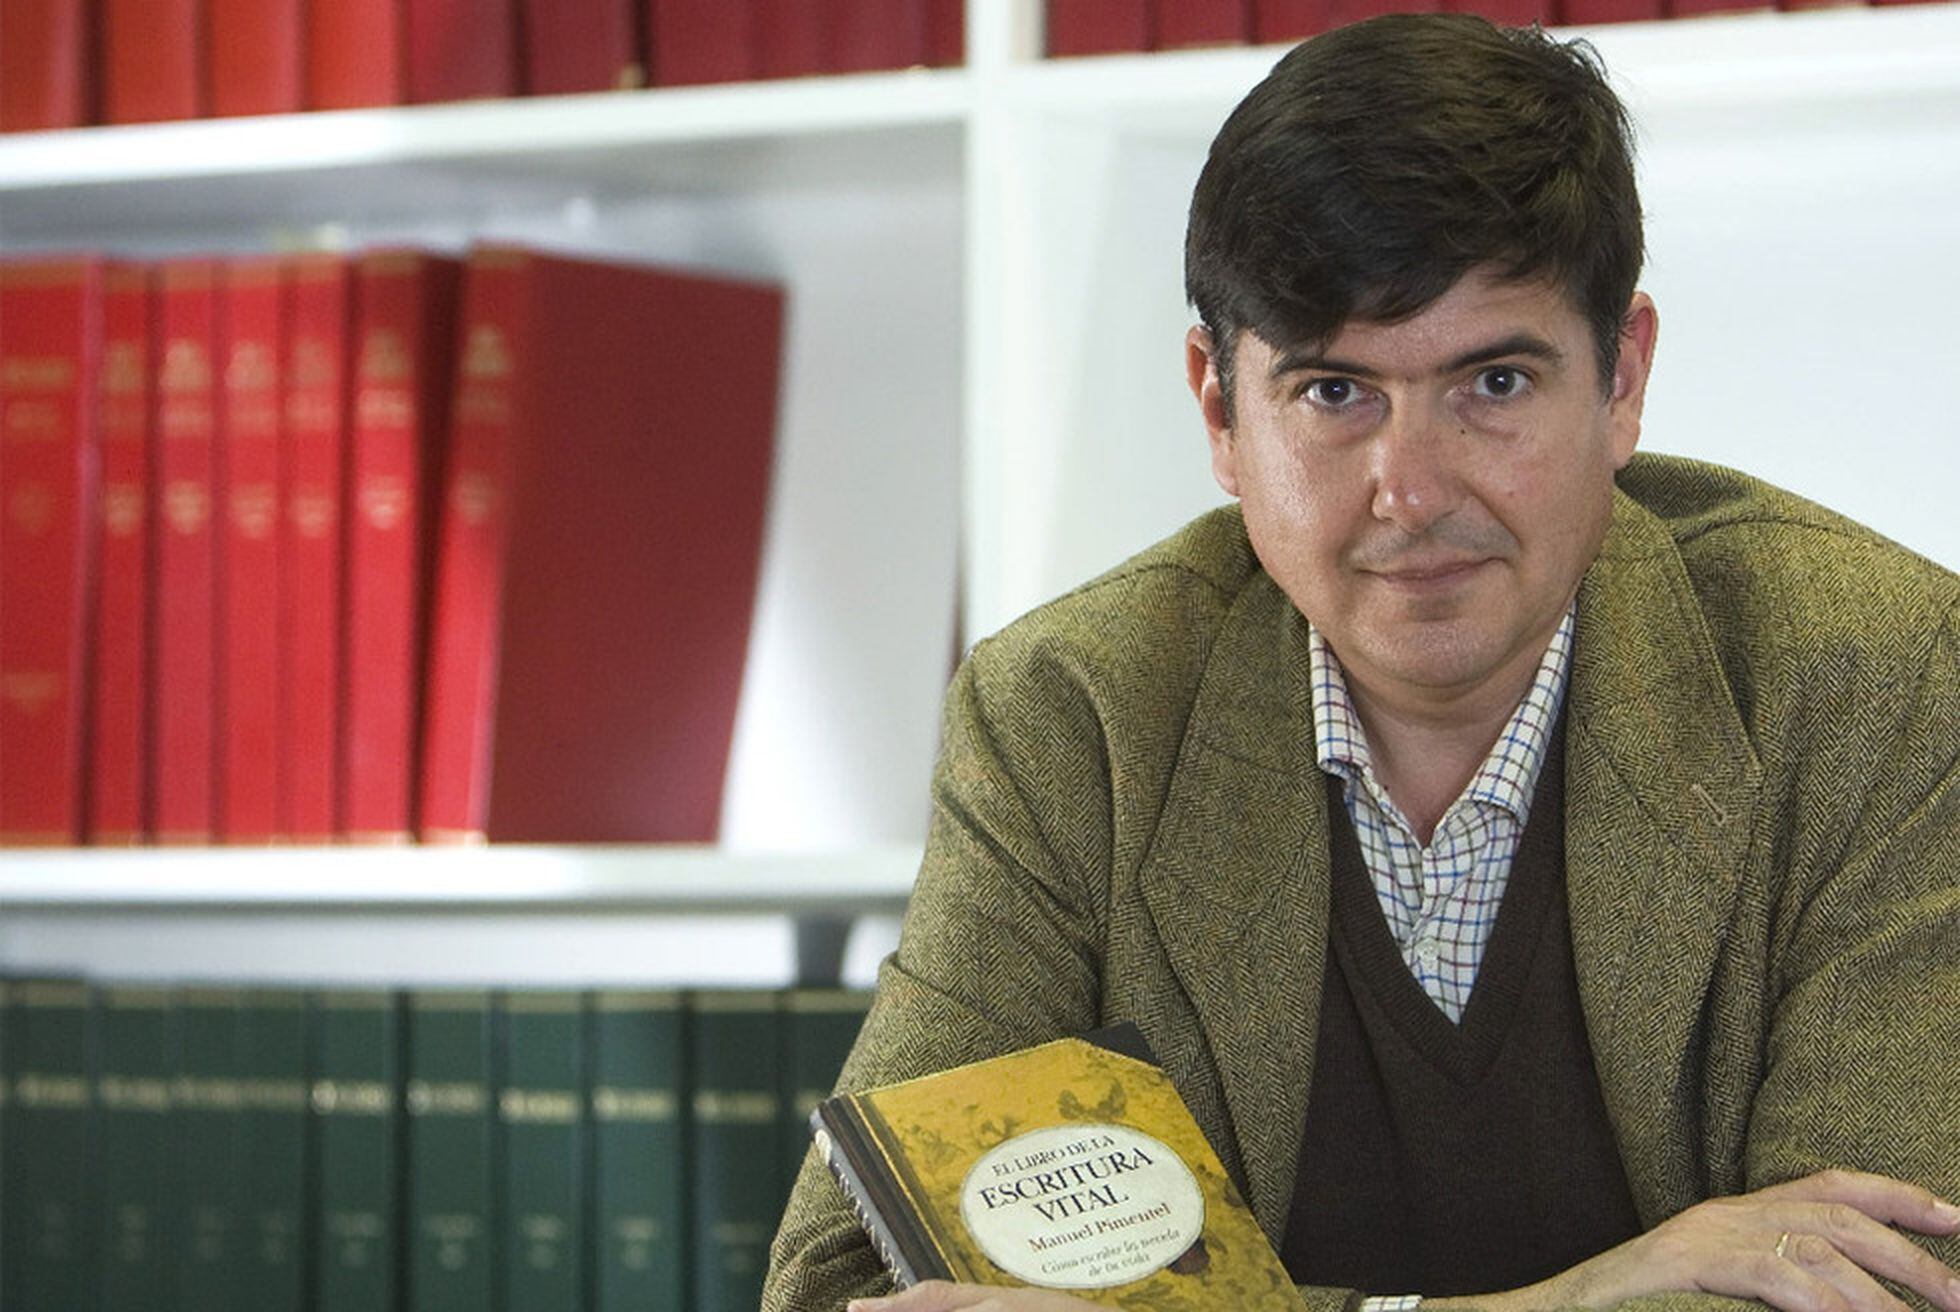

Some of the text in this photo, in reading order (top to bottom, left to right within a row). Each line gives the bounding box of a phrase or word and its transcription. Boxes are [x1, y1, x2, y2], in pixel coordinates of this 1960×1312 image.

[978, 1147, 1155, 1209] ESCRITURA
[992, 1135, 1115, 1177] EL LIBRO DE LA
[1033, 1184, 1130, 1222] VITAL
[1028, 1202, 1172, 1252] Manuel Pimentel
